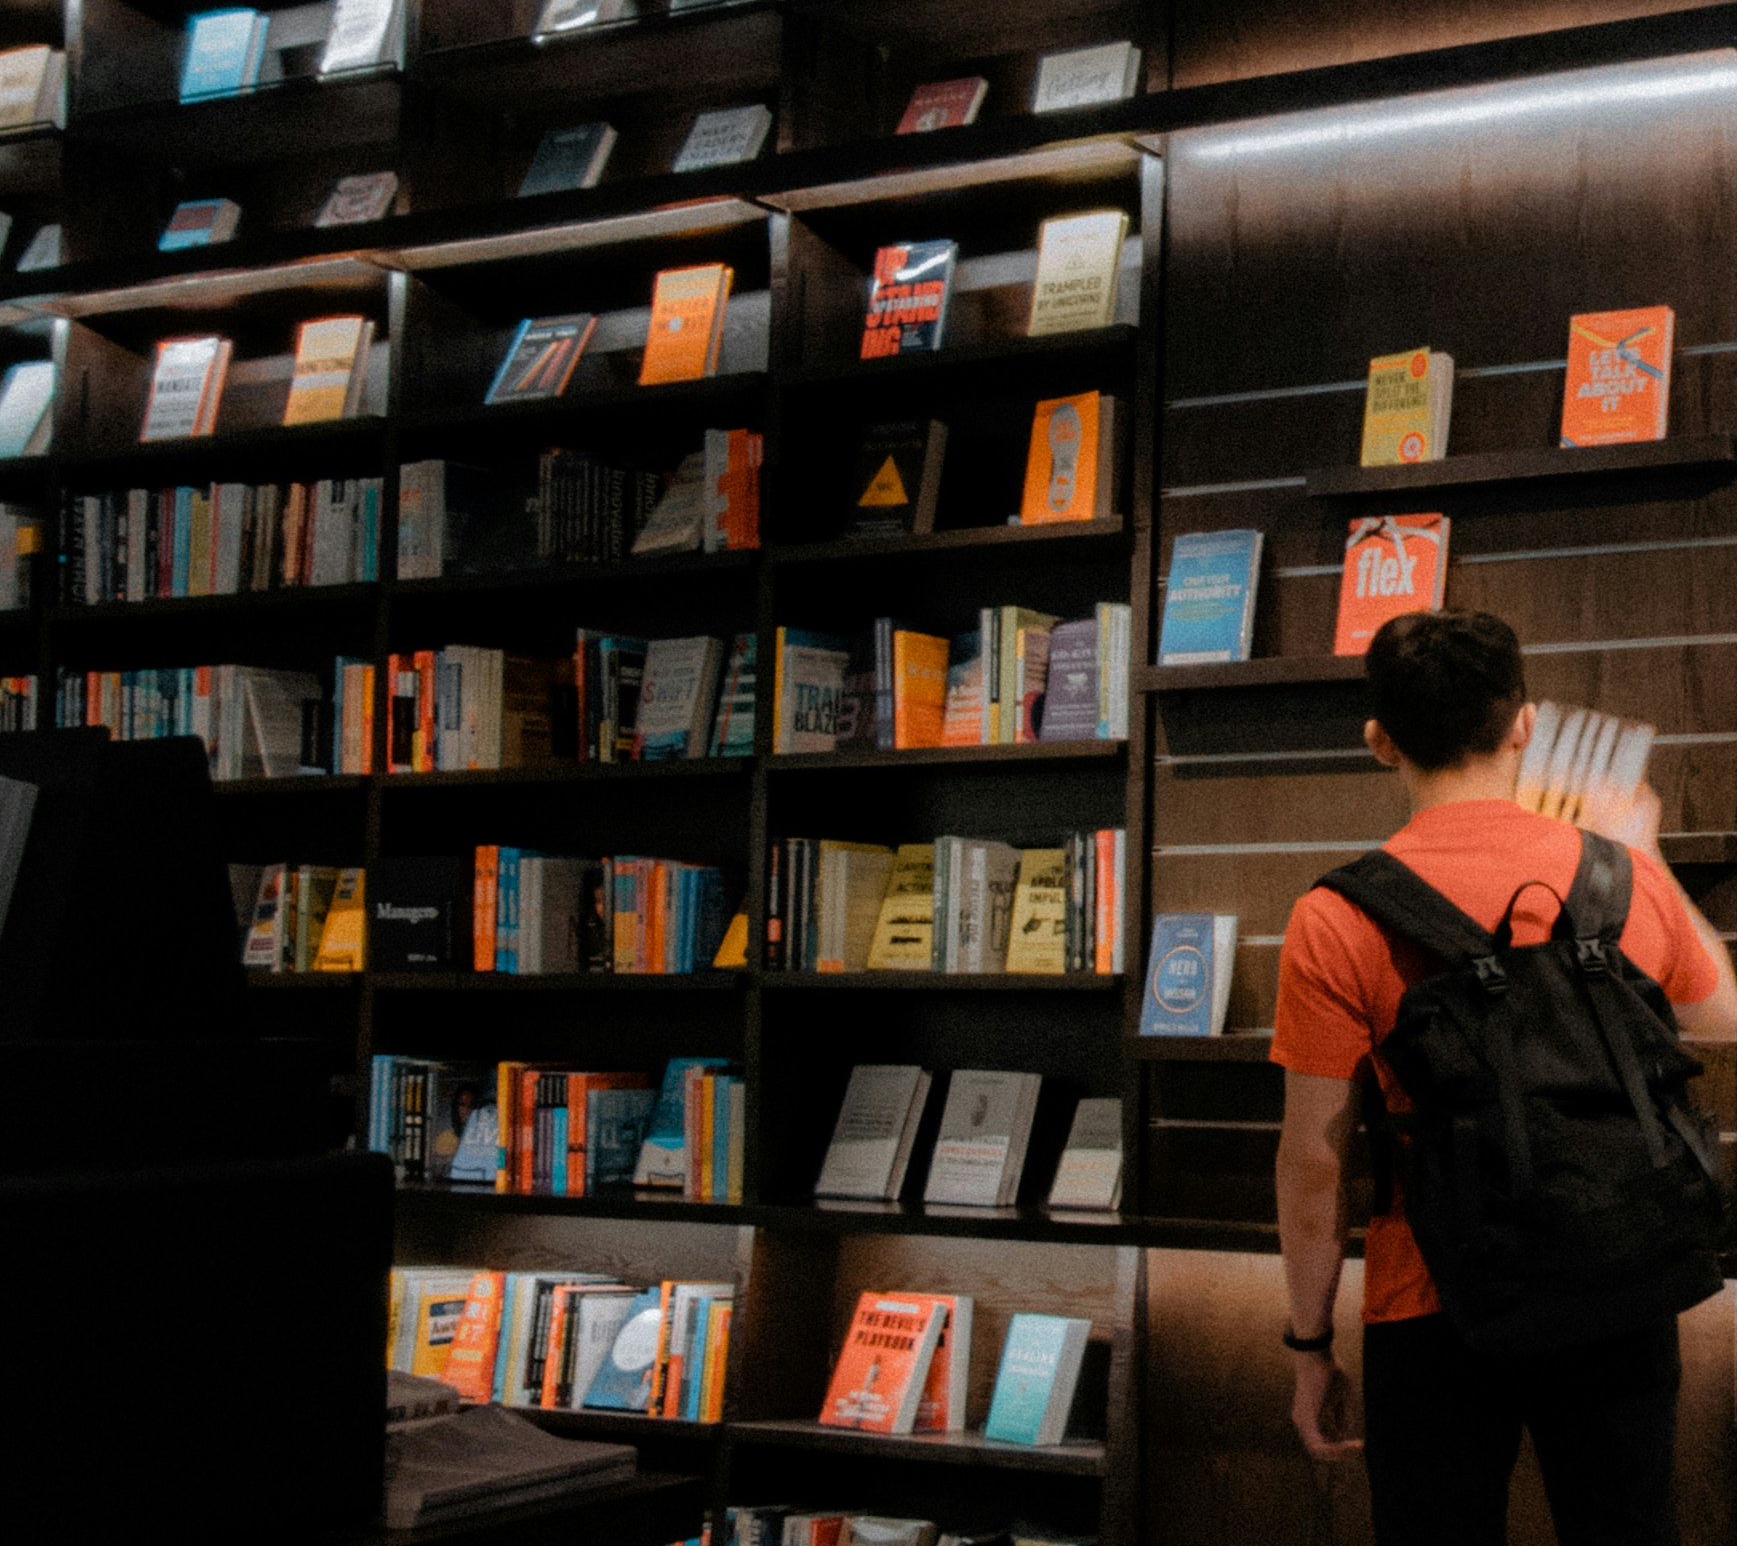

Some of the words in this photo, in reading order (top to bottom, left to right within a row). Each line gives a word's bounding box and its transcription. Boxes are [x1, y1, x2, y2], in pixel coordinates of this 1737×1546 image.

[1577, 377, 1648, 399] ABOUT
[1601, 395, 1621, 413] IT
[1357, 546, 1417, 598] flex
[855, 1330, 915, 1352] PLAYBOOK
